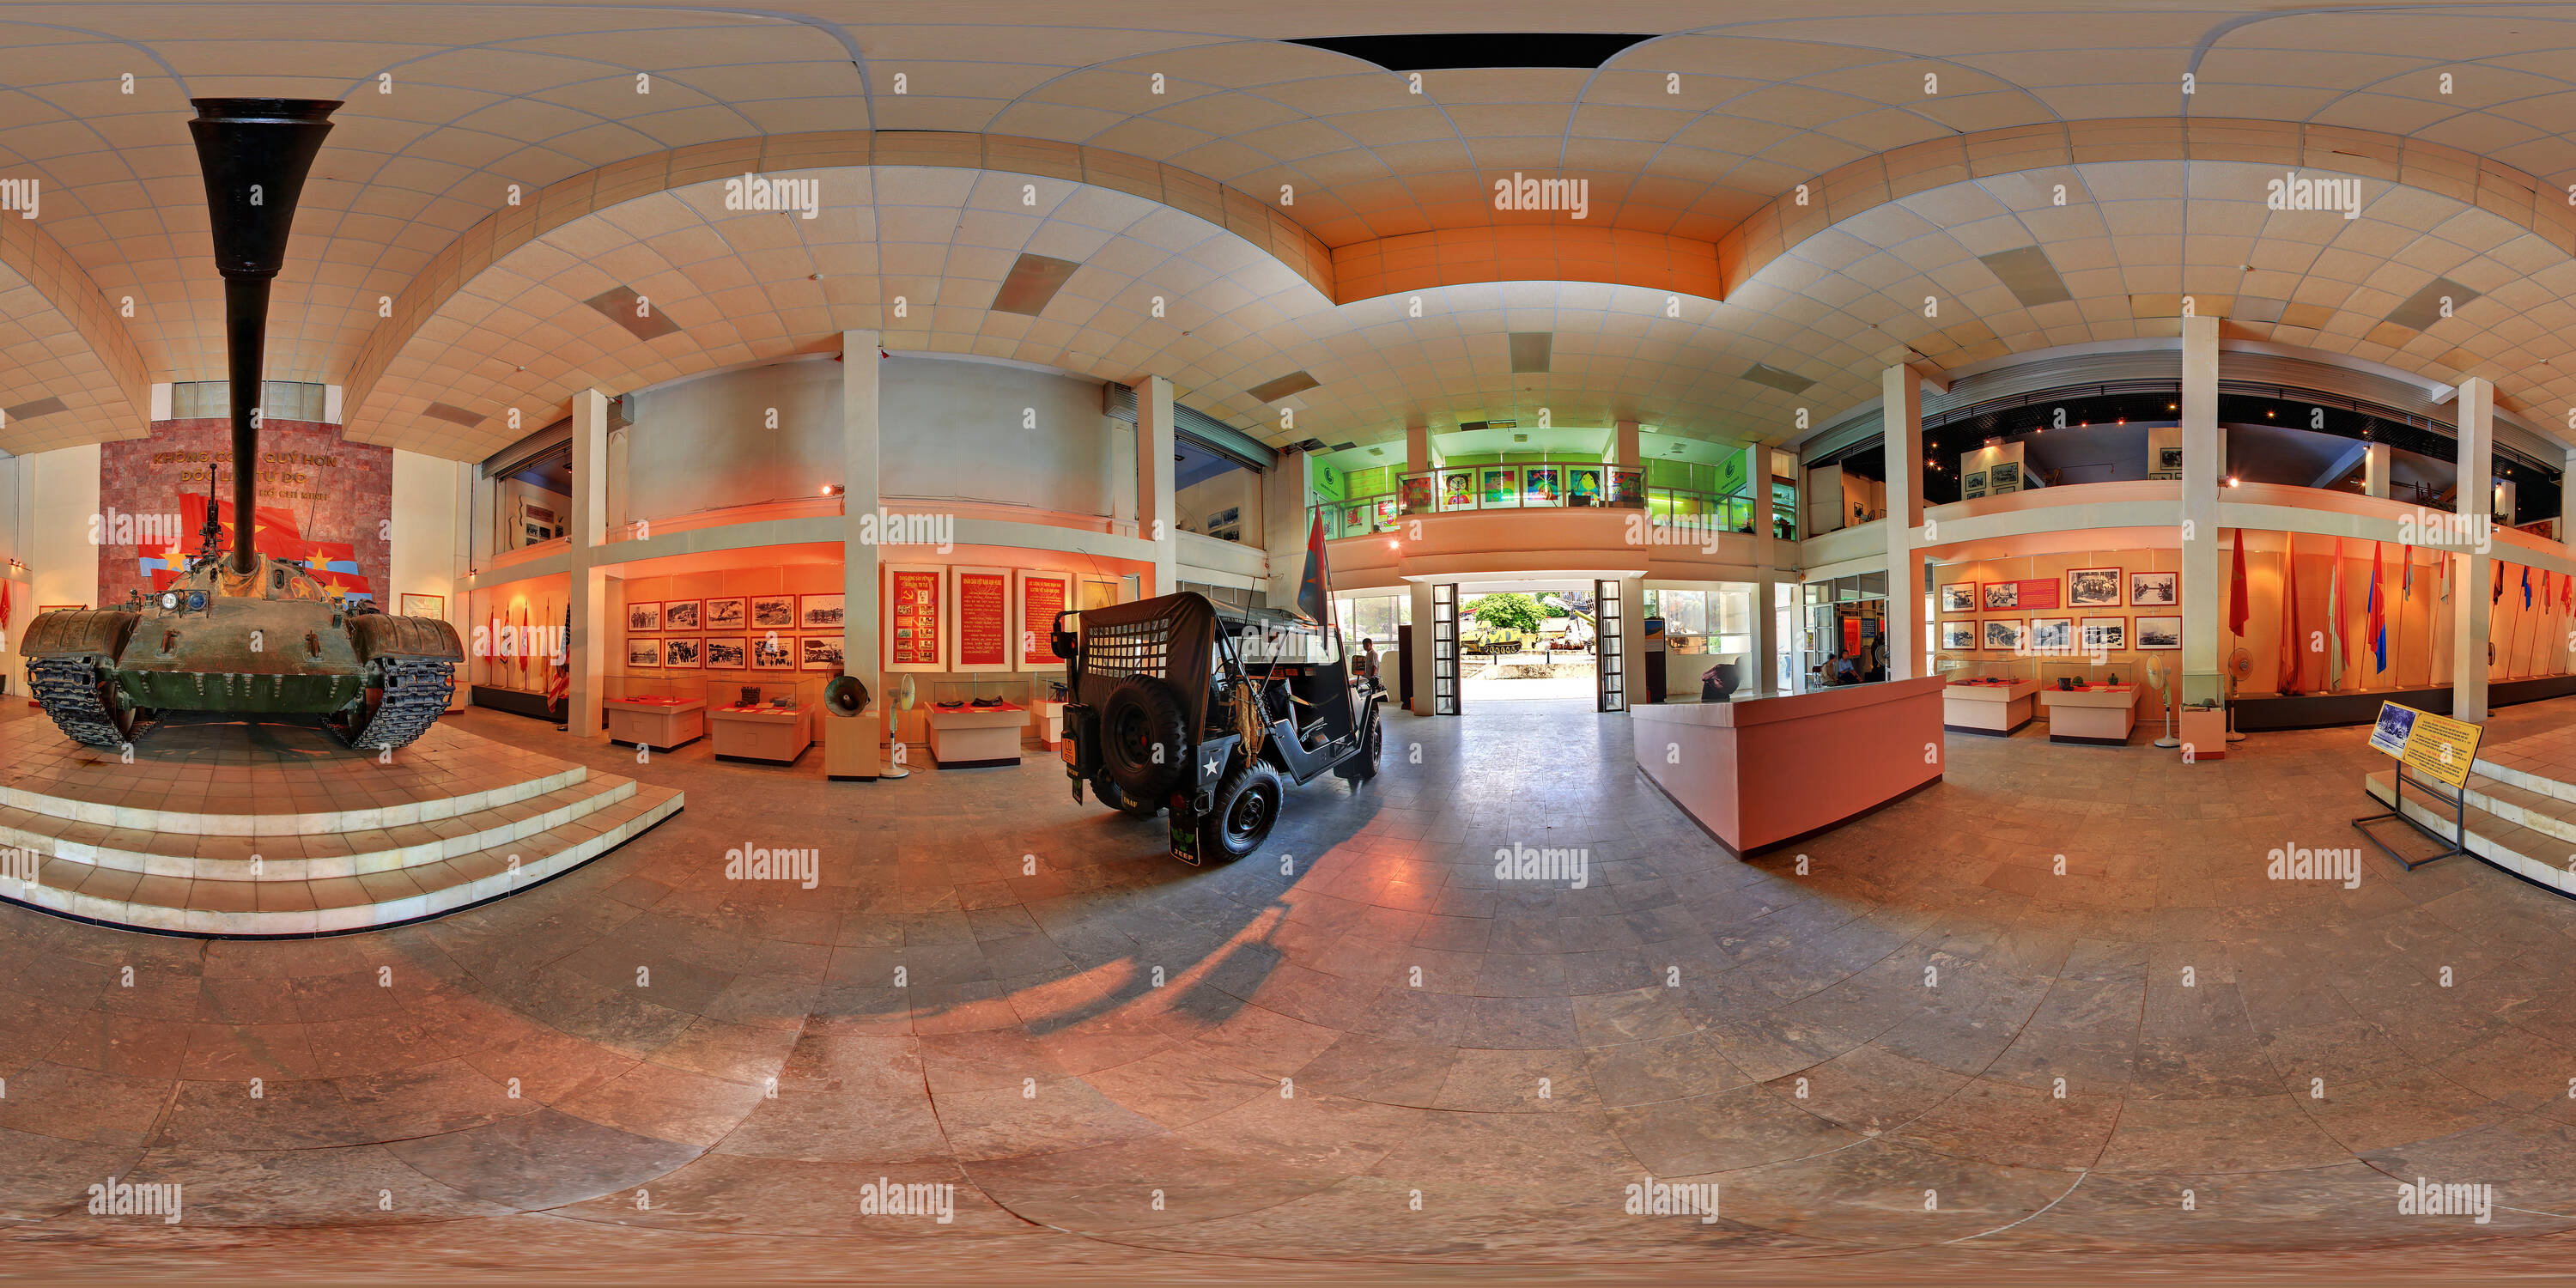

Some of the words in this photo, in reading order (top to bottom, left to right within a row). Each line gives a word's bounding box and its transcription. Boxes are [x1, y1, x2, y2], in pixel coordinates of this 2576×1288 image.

[153, 449, 209, 464] KHÔNG
[264, 450, 297, 464] QUÝ
[282, 471, 307, 483] DO
[301, 492, 327, 501] MINH
[1174, 848, 1194, 860] JEEP
